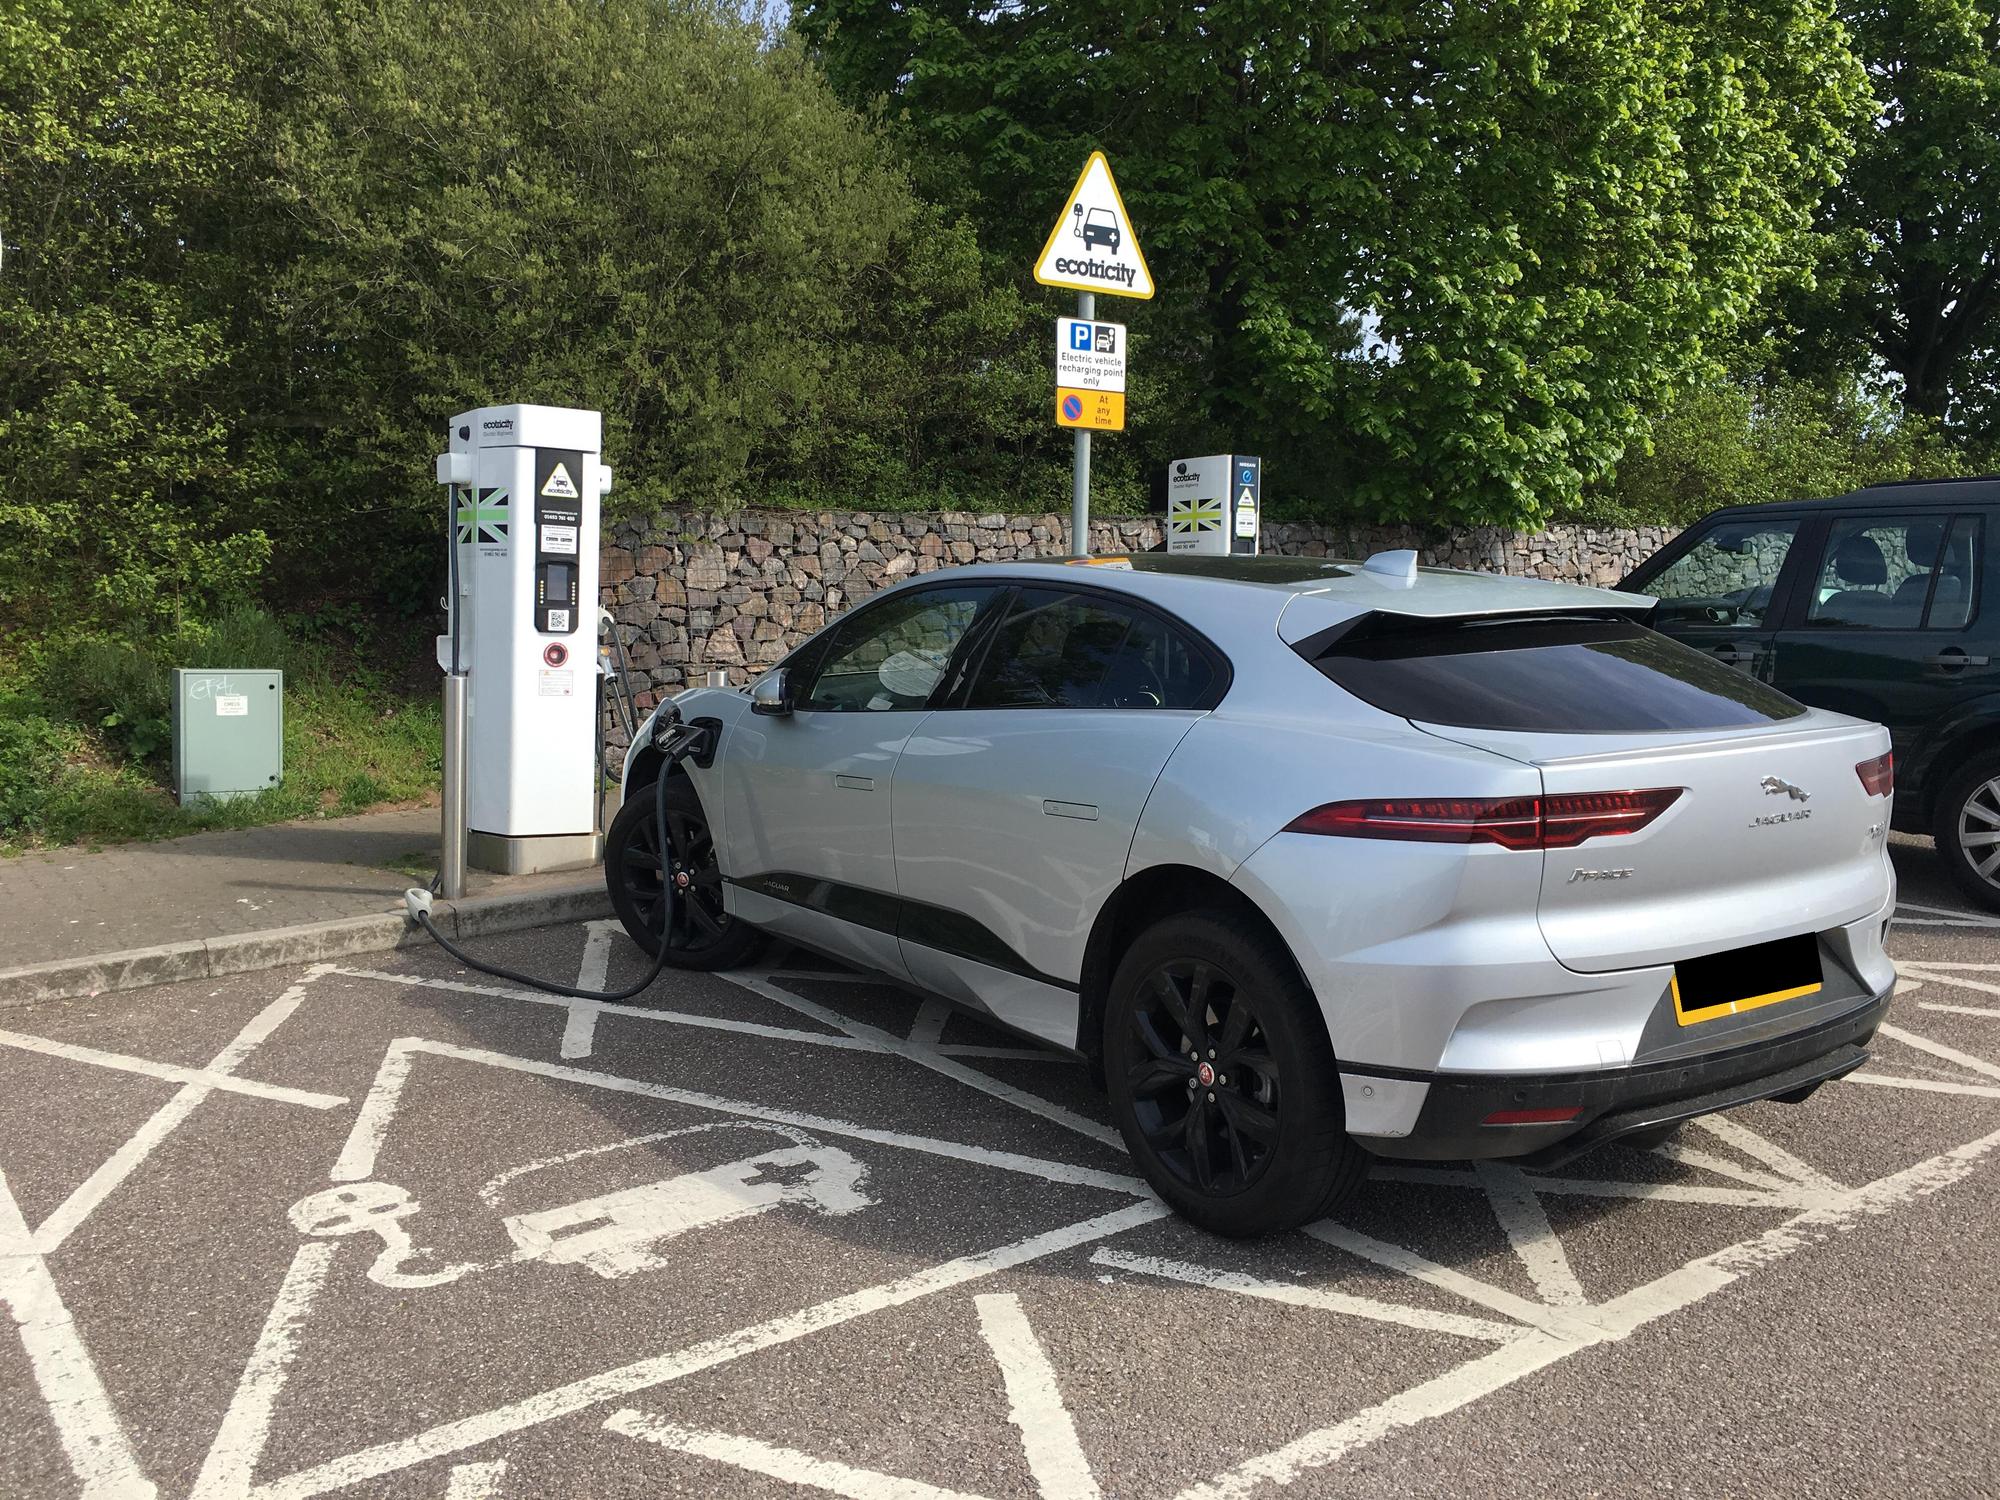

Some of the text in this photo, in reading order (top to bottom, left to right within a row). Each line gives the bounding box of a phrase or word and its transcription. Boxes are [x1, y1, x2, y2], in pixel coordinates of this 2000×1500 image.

[1055, 257, 1136, 288] ecotricity
[1075, 325, 1089, 348] P
[1061, 352, 1122, 367] Electric vehicle
[1059, 364, 1123, 377] recharging point
[1083, 377, 1100, 386] only
[1099, 395, 1108, 404] At
[1096, 407, 1110, 416] any
[483, 419, 513, 430] ecotricity
[1095, 416, 1112, 425] time
[1173, 473, 1200, 482] ecotricity
[1749, 809, 1811, 828] JAGUAR
[763, 879, 790, 892] JAGUAR
